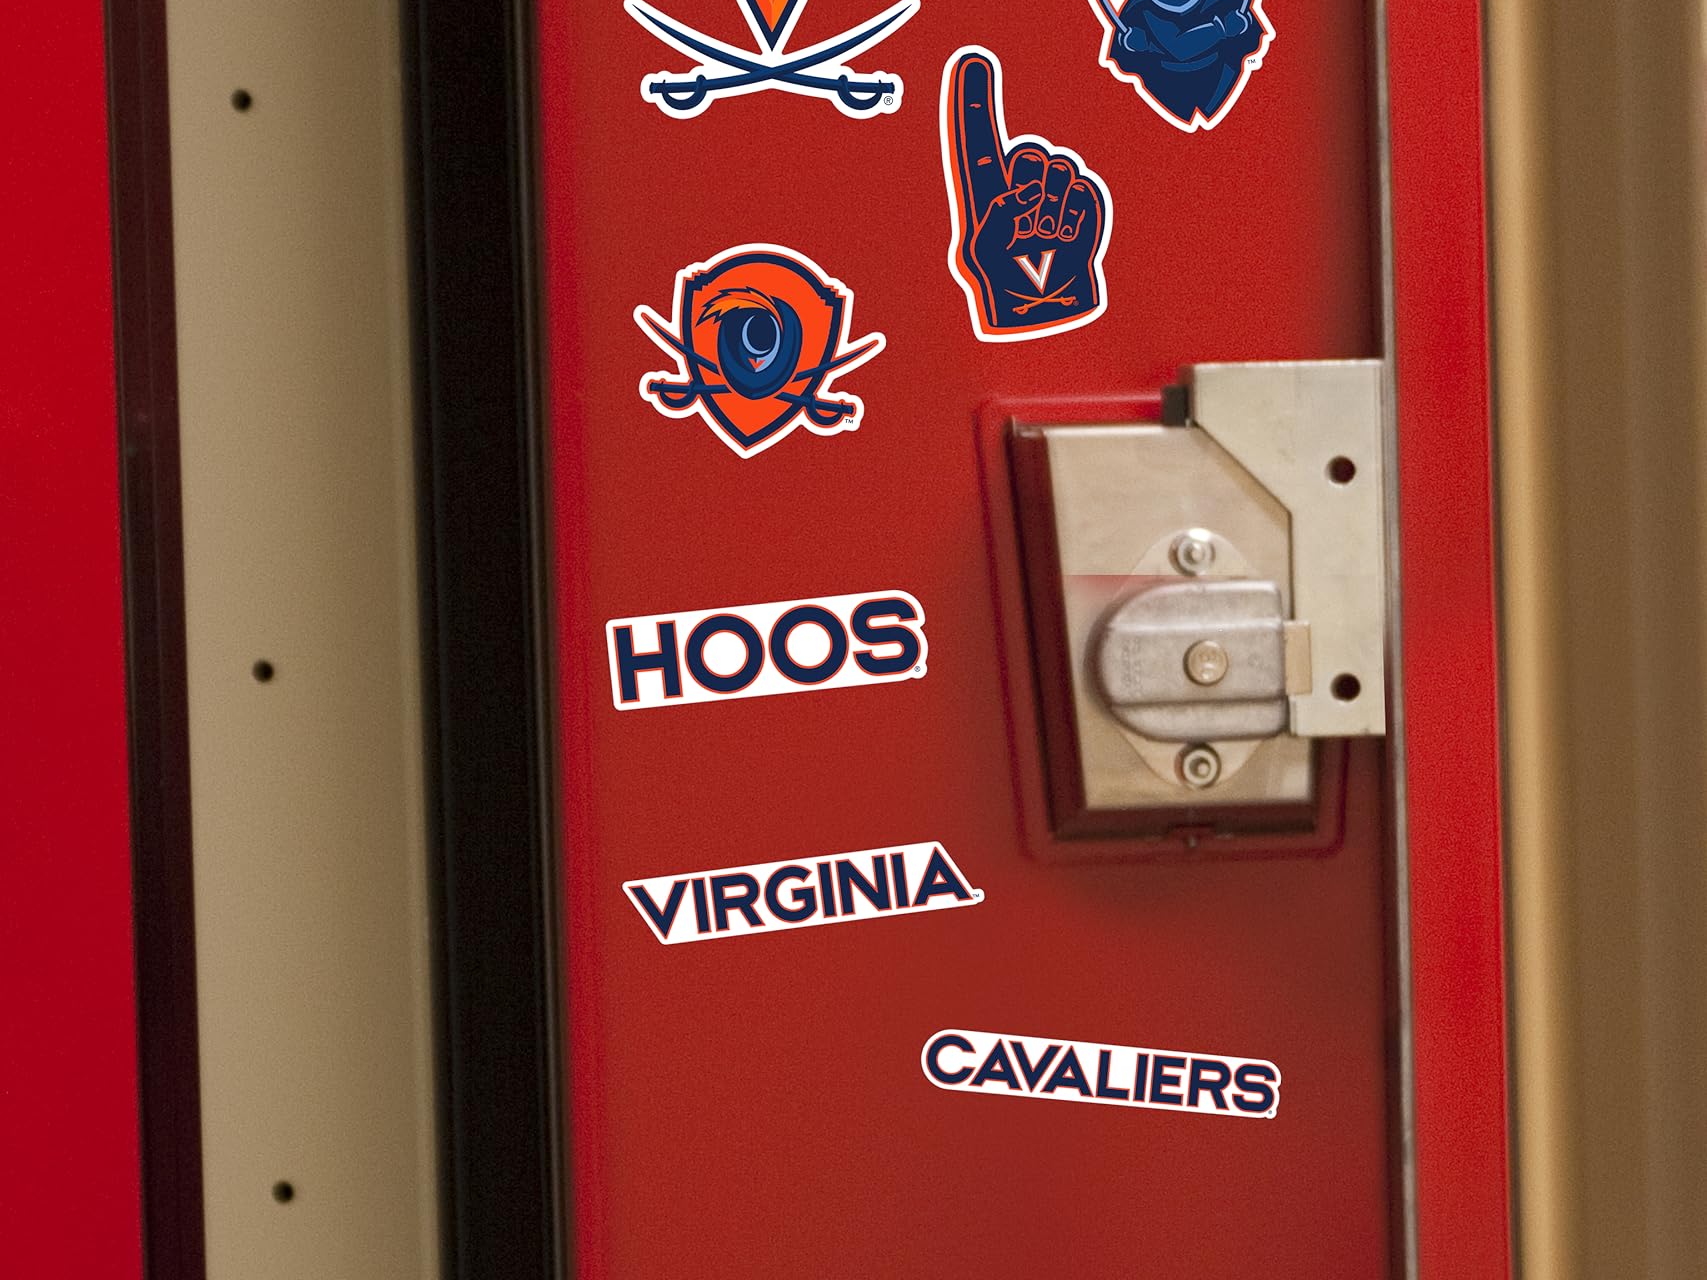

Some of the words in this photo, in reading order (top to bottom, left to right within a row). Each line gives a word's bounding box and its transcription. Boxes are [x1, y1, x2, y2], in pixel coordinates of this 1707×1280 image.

[613, 596, 922, 704] HOOS
[628, 846, 974, 941] VIRGINIA
[925, 1033, 1277, 1113] CAVALIERS
